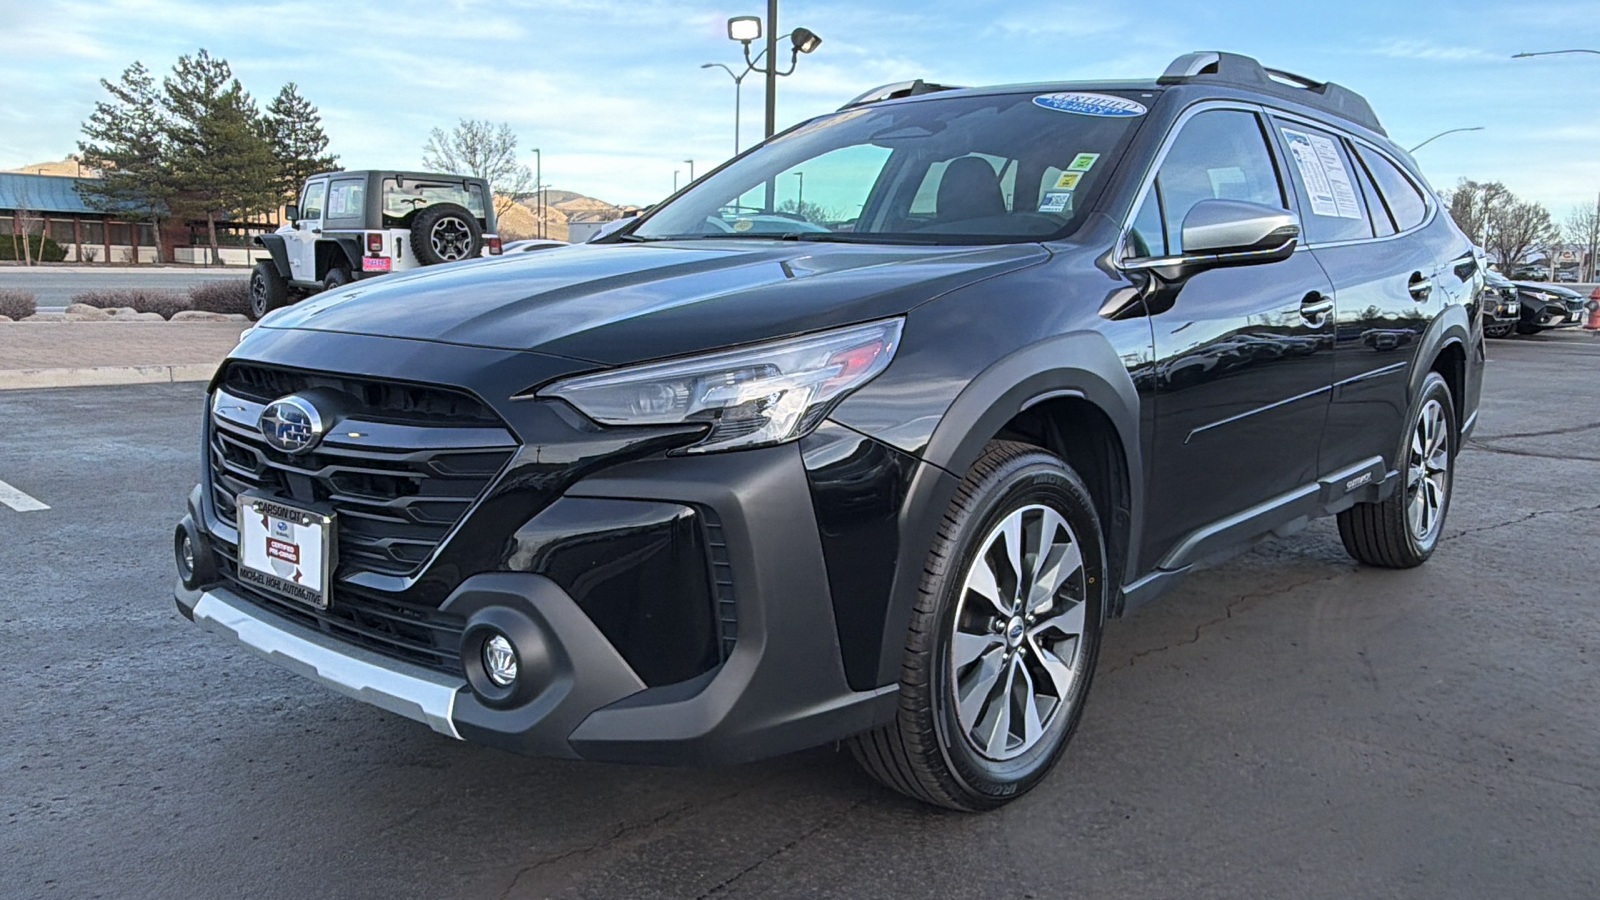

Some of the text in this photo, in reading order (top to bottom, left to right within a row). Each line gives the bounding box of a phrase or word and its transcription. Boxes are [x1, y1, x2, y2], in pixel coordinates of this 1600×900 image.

[258, 502, 287, 518] CARSON
[270, 541, 295, 554] CERTIFIED
[239, 567, 322, 606] MICHAEL HOHL AUTOMOTIVE
